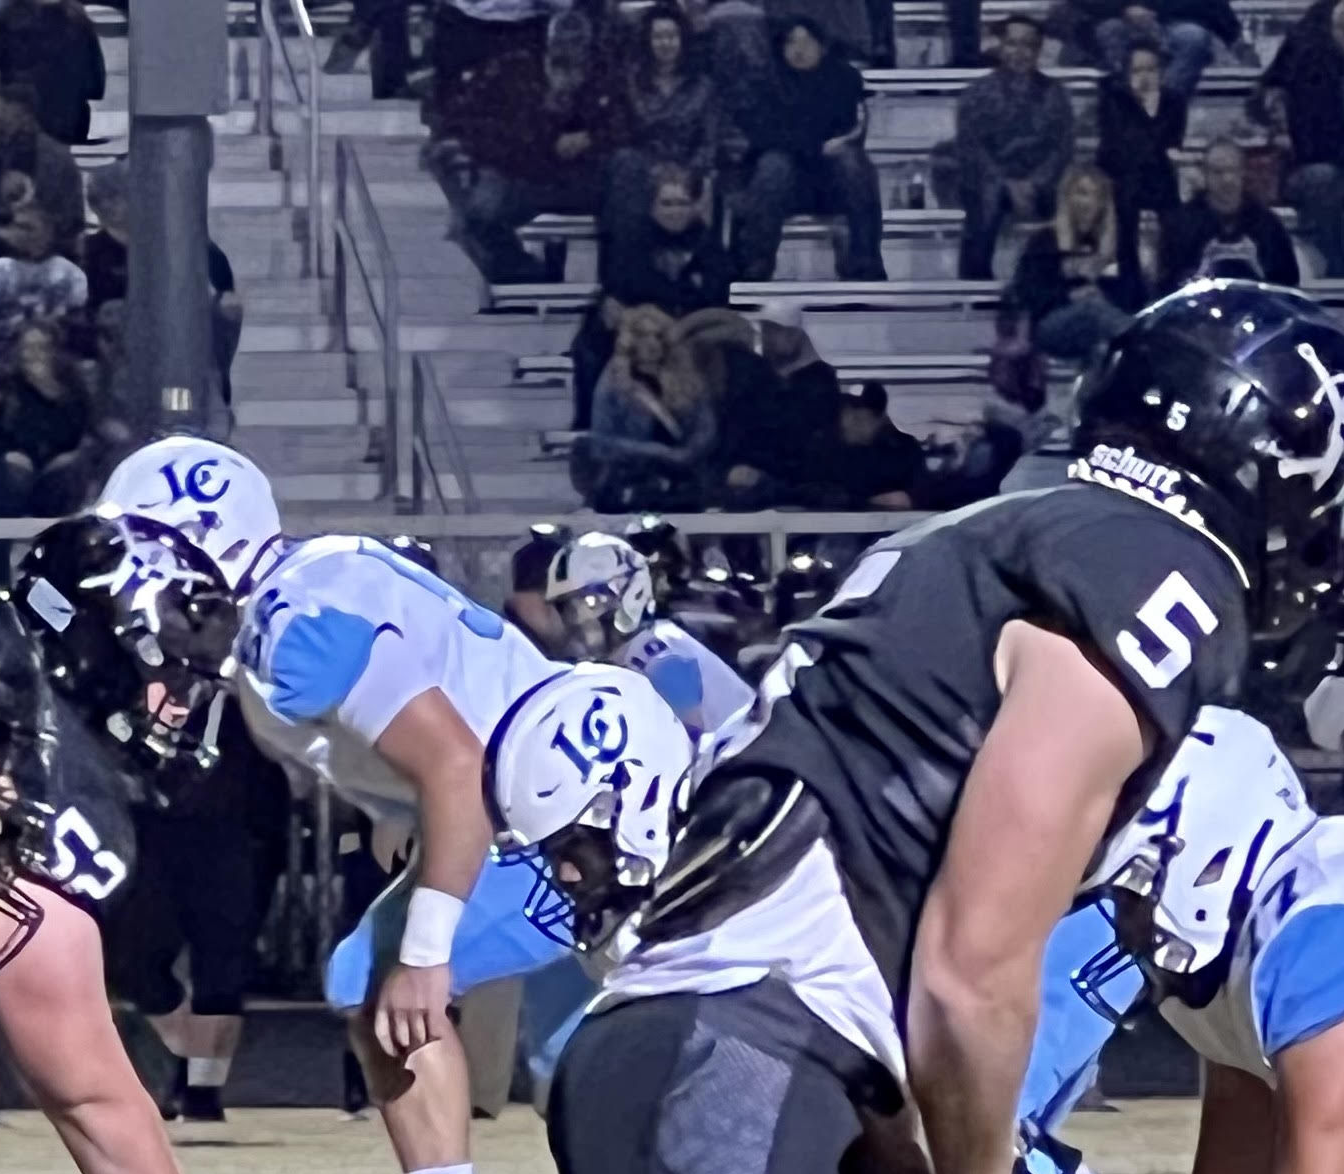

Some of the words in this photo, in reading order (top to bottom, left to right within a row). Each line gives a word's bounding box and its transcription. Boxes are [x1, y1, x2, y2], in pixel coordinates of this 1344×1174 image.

[1165, 401, 1191, 431] 5
[1116, 570, 1220, 689] 5
[50, 806, 127, 900] 53
